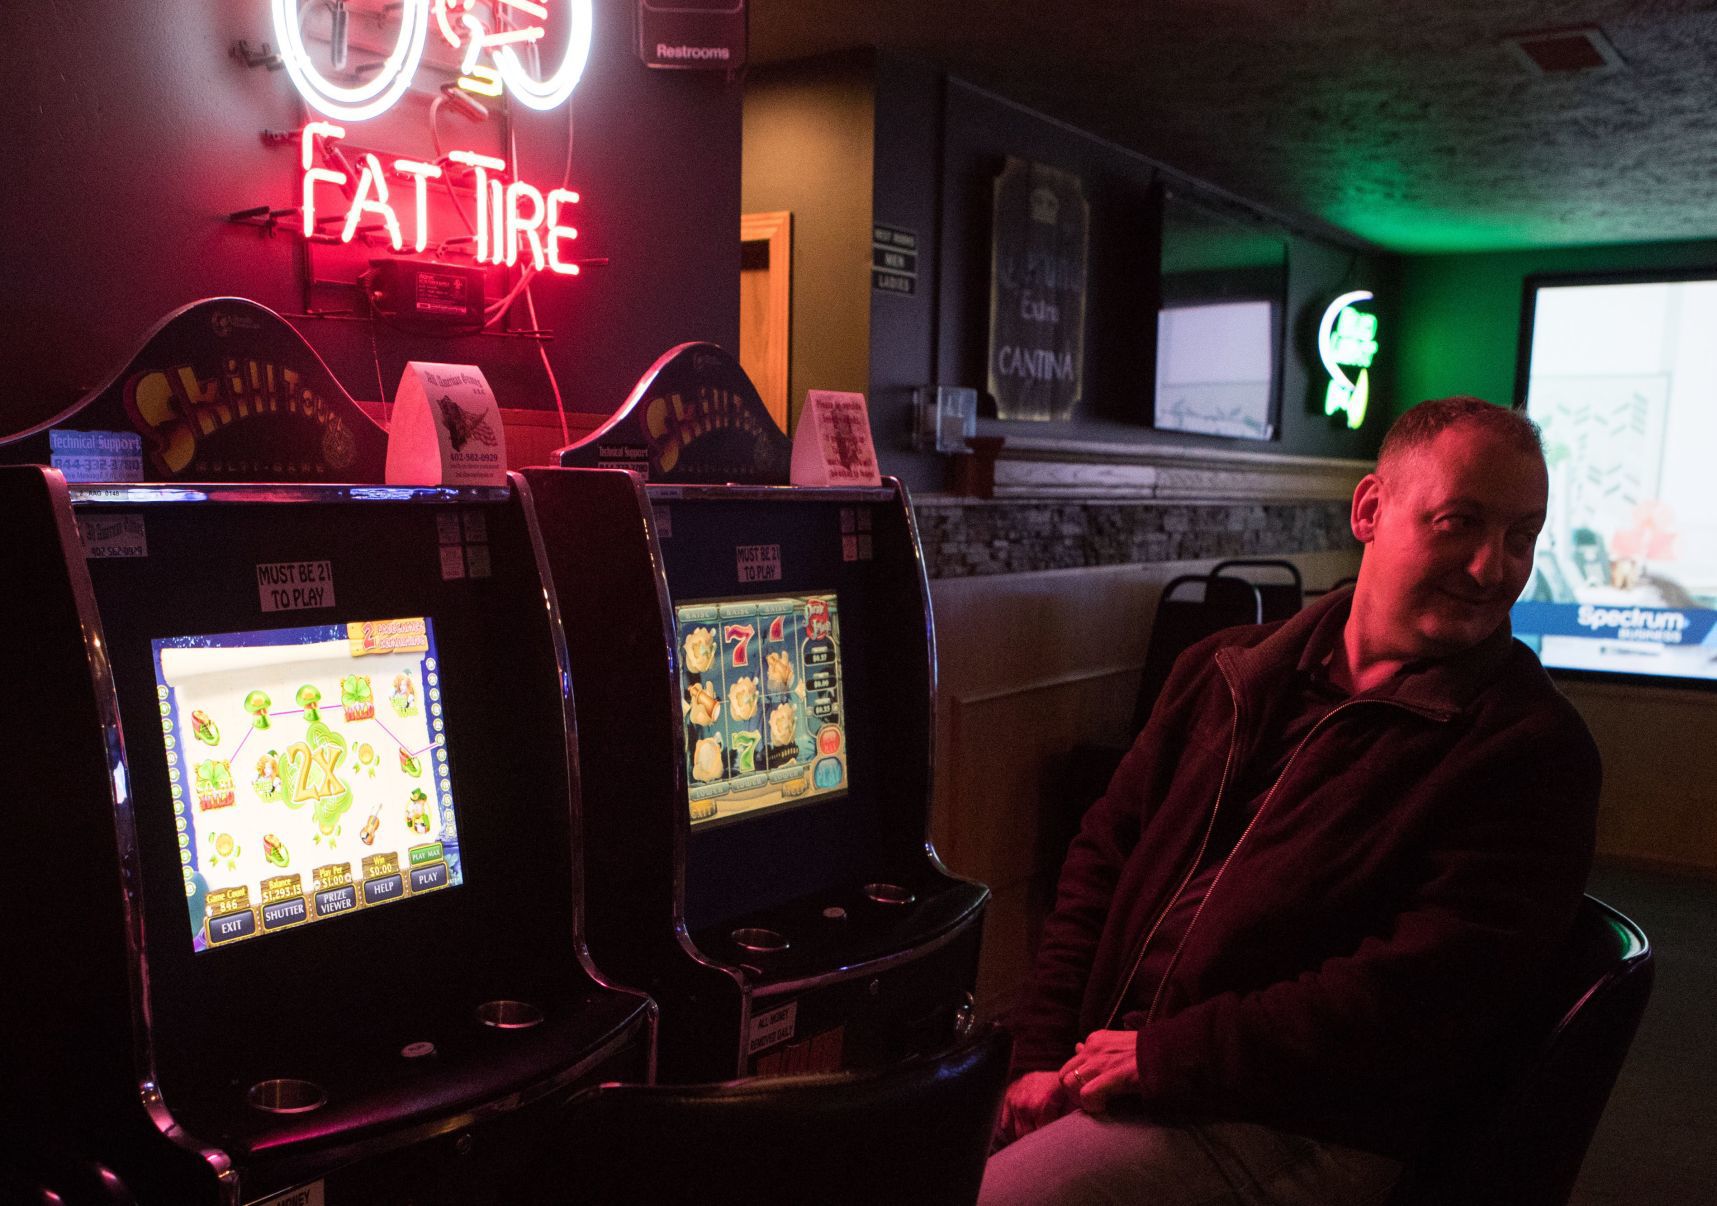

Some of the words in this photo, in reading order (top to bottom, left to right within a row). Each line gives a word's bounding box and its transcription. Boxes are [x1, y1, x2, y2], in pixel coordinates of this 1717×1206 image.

[656, 43, 730, 60] Restrooms
[302, 122, 442, 254] FAT
[448, 151, 581, 275] TIRE
[999, 344, 1074, 382] CANTINA
[54, 434, 96, 449] Technical
[98, 435, 142, 453] Support
[737, 547, 760, 563] MUST
[760, 546, 771, 562] BE
[771, 545, 780, 561] 21
[258, 564, 296, 586] MUST
[298, 563, 316, 583] BE
[317, 562, 332, 582] 21
[744, 565, 756, 580] TO
[756, 564, 776, 579] PLAY
[271, 589, 291, 609] TO
[292, 586, 324, 608] PLAY
[1577, 604, 1686, 631] Spectrum
[286, 741, 347, 803] 2X
[373, 855, 385, 865] Win
[412, 853, 426, 861] PLAY
[428, 849, 441, 858] MAX
[319, 867, 332, 878] Play
[333, 866, 343, 875] Per
[369, 863, 392, 877] $0.00
[418, 871, 438, 885] PLAY
[268, 878, 292, 890] Balance
[322, 875, 344, 888] $1.00
[373, 881, 394, 895] HELP
[206, 893, 226, 904] Game
[226, 887, 247, 900] Count
[323, 890, 347, 904] PRIZE
[265, 904, 305, 922] SHUTTER
[320, 898, 352, 914] VIEWER
[221, 919, 242, 934] EXIT
[770, 1007, 790, 1025] MONEY
